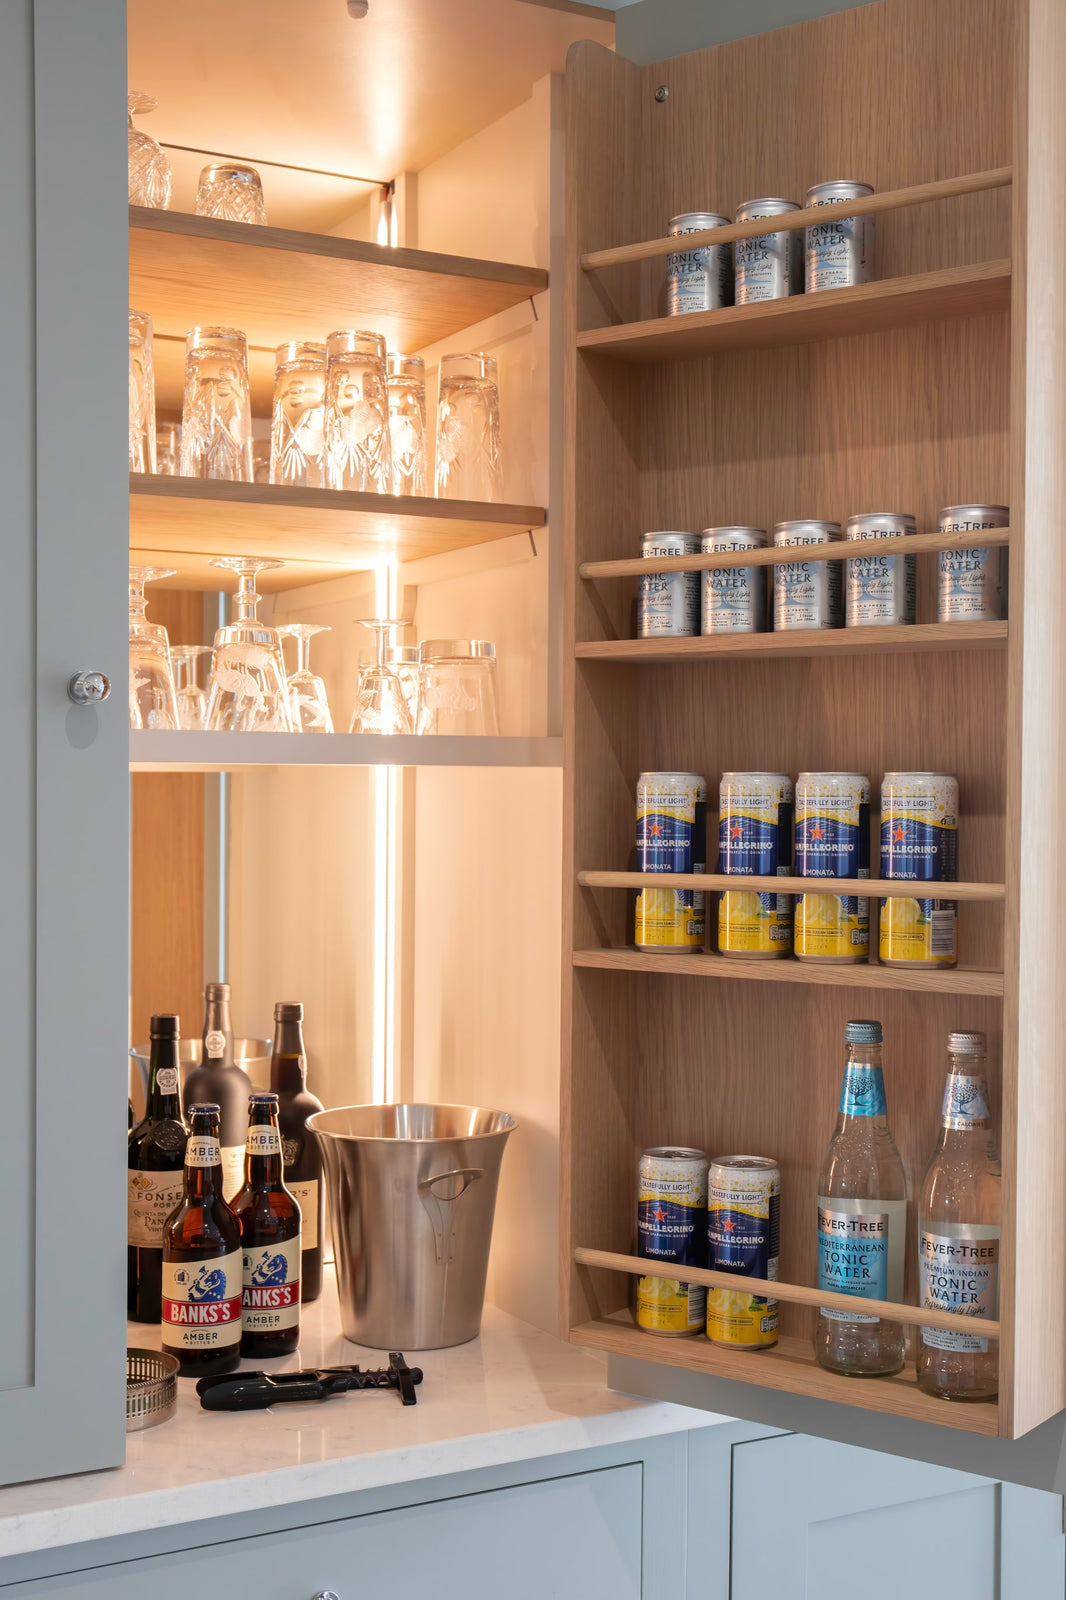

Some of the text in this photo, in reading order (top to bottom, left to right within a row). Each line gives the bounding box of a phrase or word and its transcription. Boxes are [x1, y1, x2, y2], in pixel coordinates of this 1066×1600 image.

[808, 223, 844, 239] TONIC
[807, 235, 846, 250] WATER
[941, 549, 980, 560] TONIC
[776, 562, 809, 575] TONIC
[850, 556, 887, 569] TONIC
[941, 560, 982, 572] WATER
[708, 567, 746, 579] TONIC
[850, 567, 890, 579] WATER
[707, 578, 748, 589] WATER
[711, 1190, 741, 1200] TASTEFULLY
[818, 1214, 884, 1233] FEVER-TREE
[646, 1247, 677, 1256] LIMONATA
[921, 1237, 994, 1258] FEVER-TREE
[714, 1257, 746, 1268] LIMONATA
[825, 1250, 868, 1266] TONIC
[824, 1261, 872, 1279] WATER
[924, 1262, 989, 1278] PREMIUM INDIAN
[930, 1274, 977, 1291] TONIC
[930, 1287, 979, 1304] WATER
[925, 1296, 986, 1316] Refreshingly Light
[246, 1315, 281, 1325] AMBER
[182, 1332, 219, 1341] AMBER
